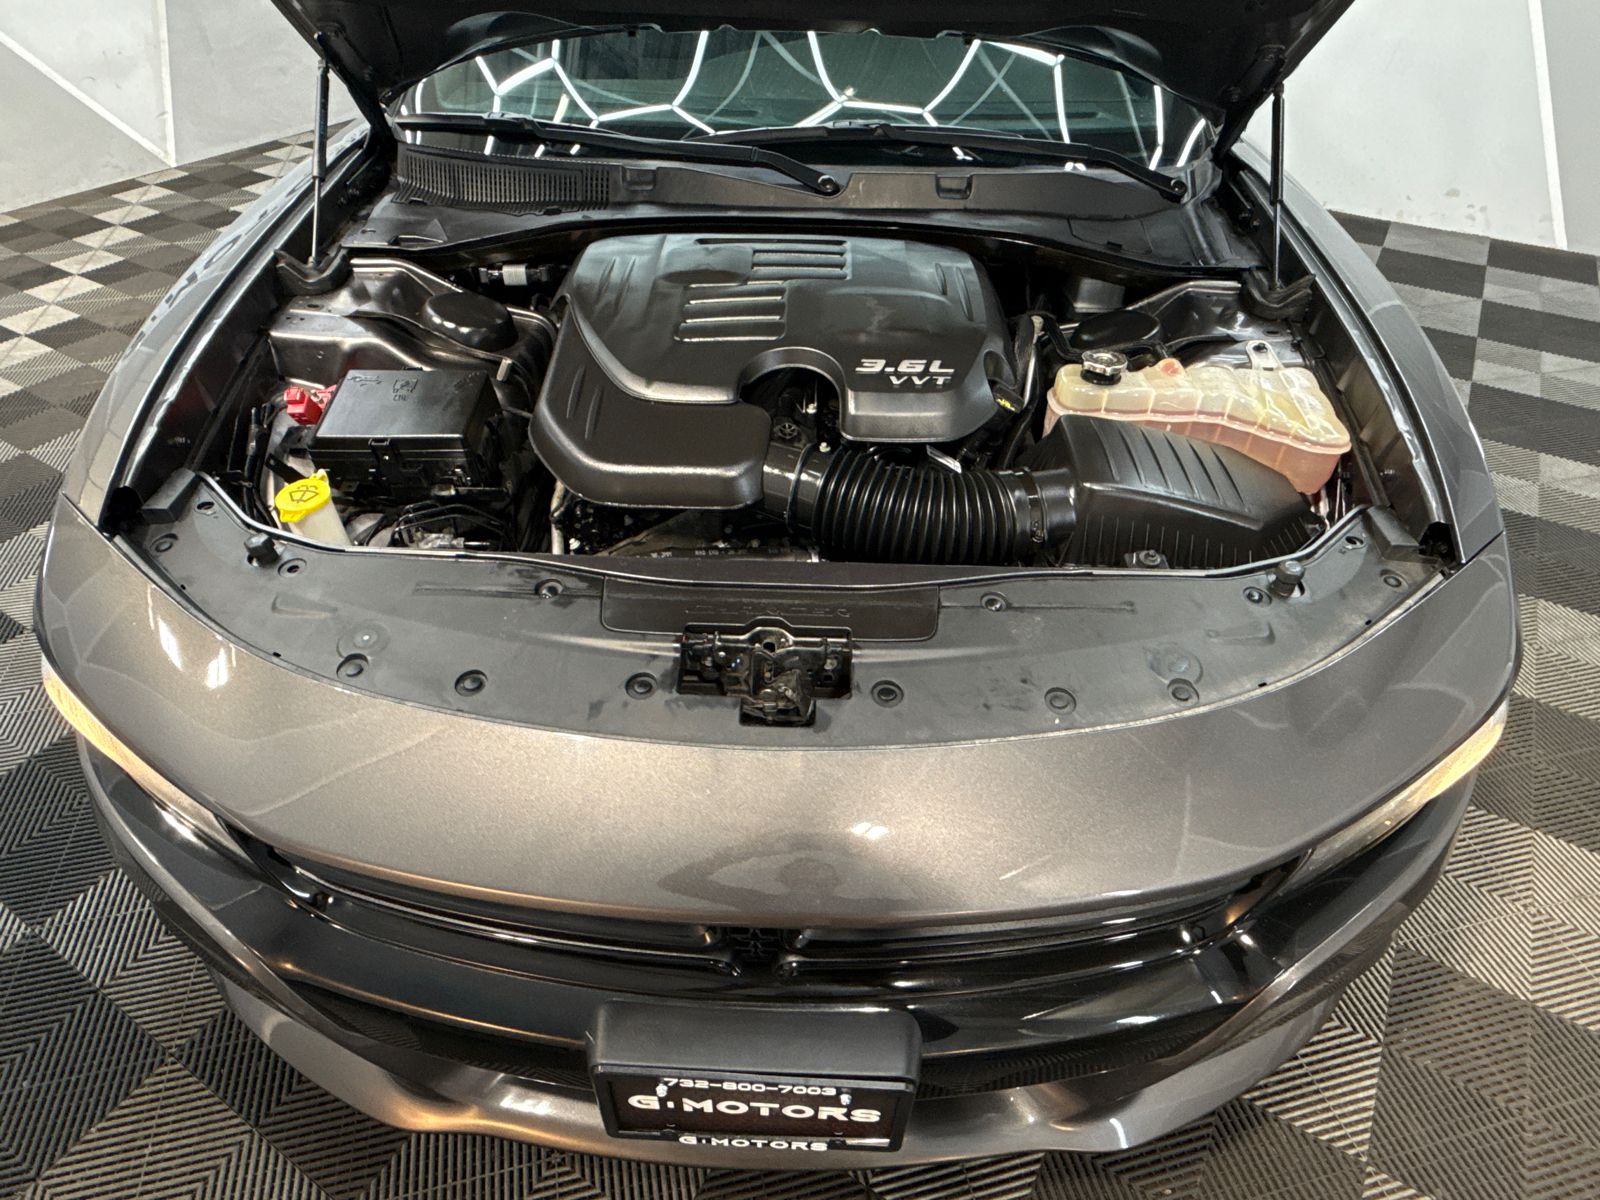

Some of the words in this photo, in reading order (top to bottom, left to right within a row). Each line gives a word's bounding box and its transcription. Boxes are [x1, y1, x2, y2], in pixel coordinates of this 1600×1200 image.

[855, 358, 955, 374] 3.6L
[888, 375, 952, 387] VVT
[663, 1077, 837, 1096] 732-800-7003
